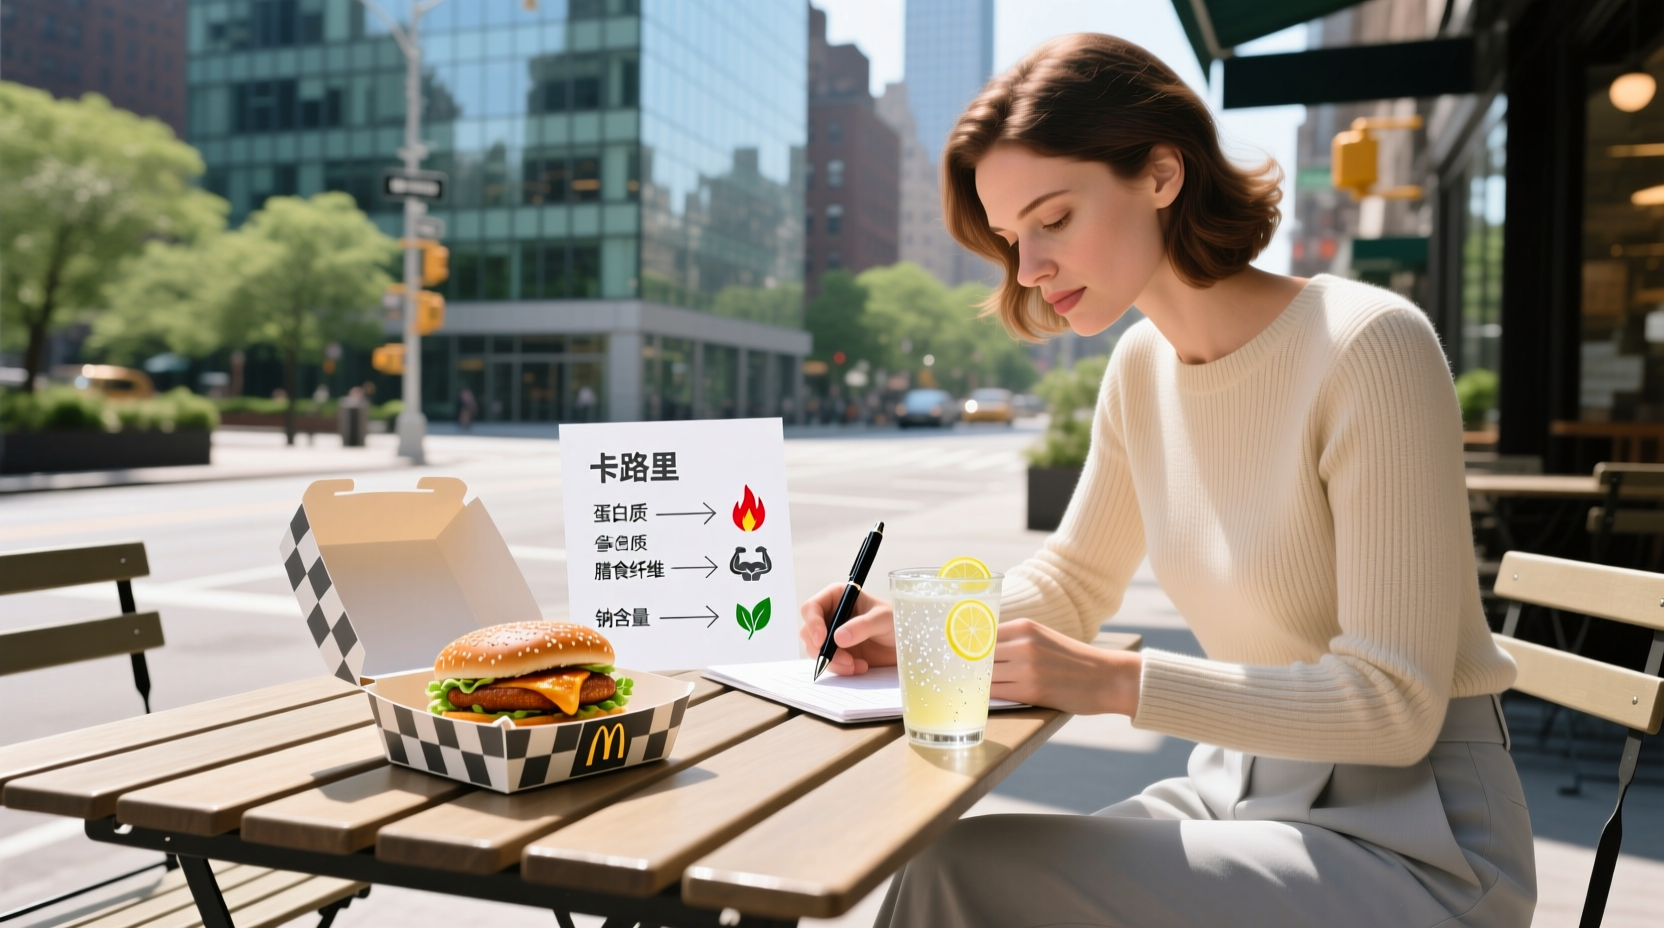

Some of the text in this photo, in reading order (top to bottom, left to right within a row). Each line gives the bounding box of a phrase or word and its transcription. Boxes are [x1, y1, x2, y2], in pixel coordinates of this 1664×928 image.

[590, 452, 679, 483] 卡路里
[593, 502, 648, 523] 蛋白质
